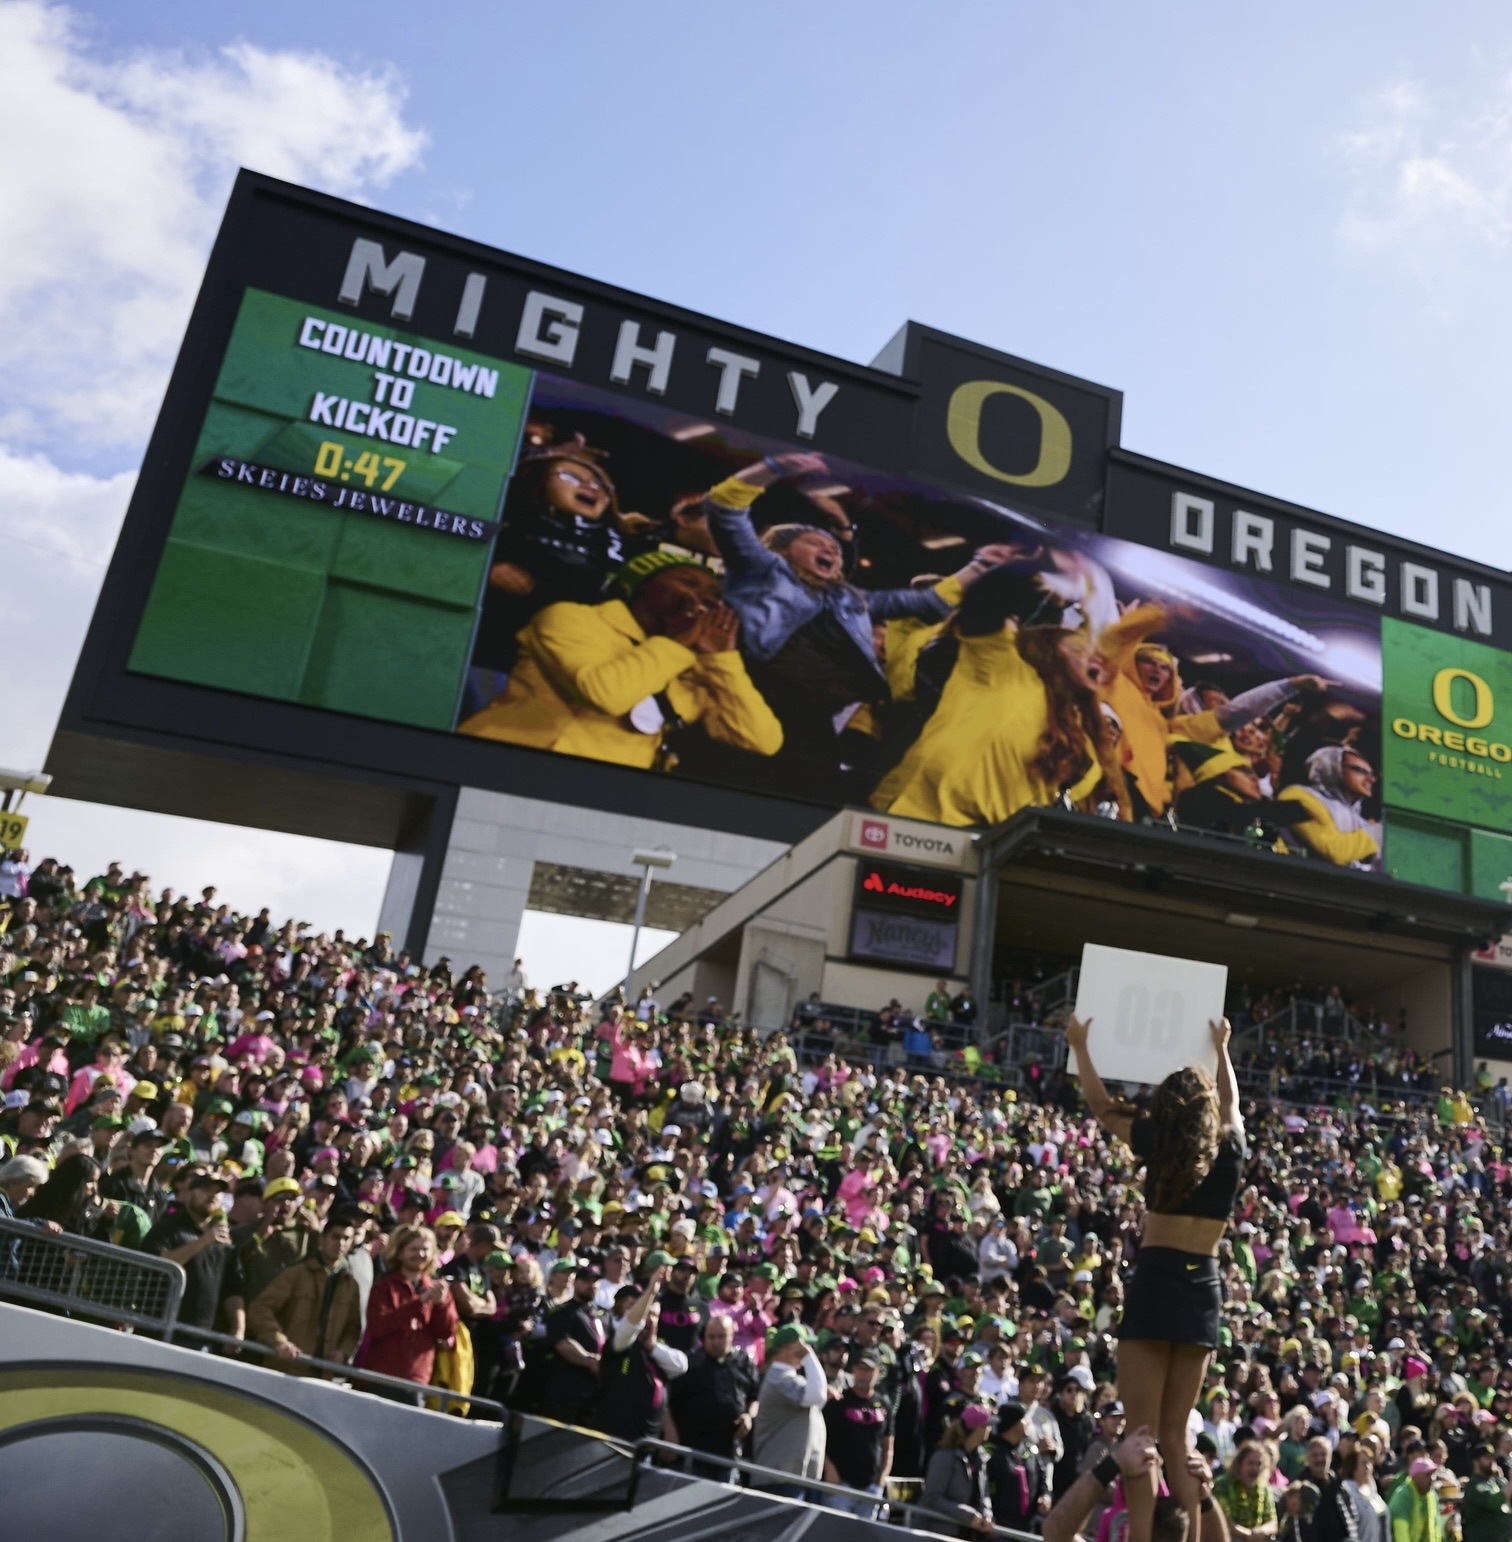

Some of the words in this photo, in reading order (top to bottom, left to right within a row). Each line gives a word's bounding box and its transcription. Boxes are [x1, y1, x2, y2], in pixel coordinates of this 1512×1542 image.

[299, 316, 499, 398] COUNTDOWN
[338, 237, 839, 440] MIGHTY
[374, 372, 416, 409] TO
[310, 392, 458, 454] KICKOFF
[947, 380, 1072, 487] O
[314, 441, 406, 492] 0:47
[218, 459, 326, 499] SKEIE'S
[333, 488, 484, 538] JEWELERS
[1170, 491, 1492, 635] OREGON
[1433, 668, 1494, 729] O
[1429, 751, 1502, 779] FOOTBALL
[1, 820, 22, 840] 19
[894, 832, 953, 854] TOYOTA
[887, 883, 956, 907] Audacy
